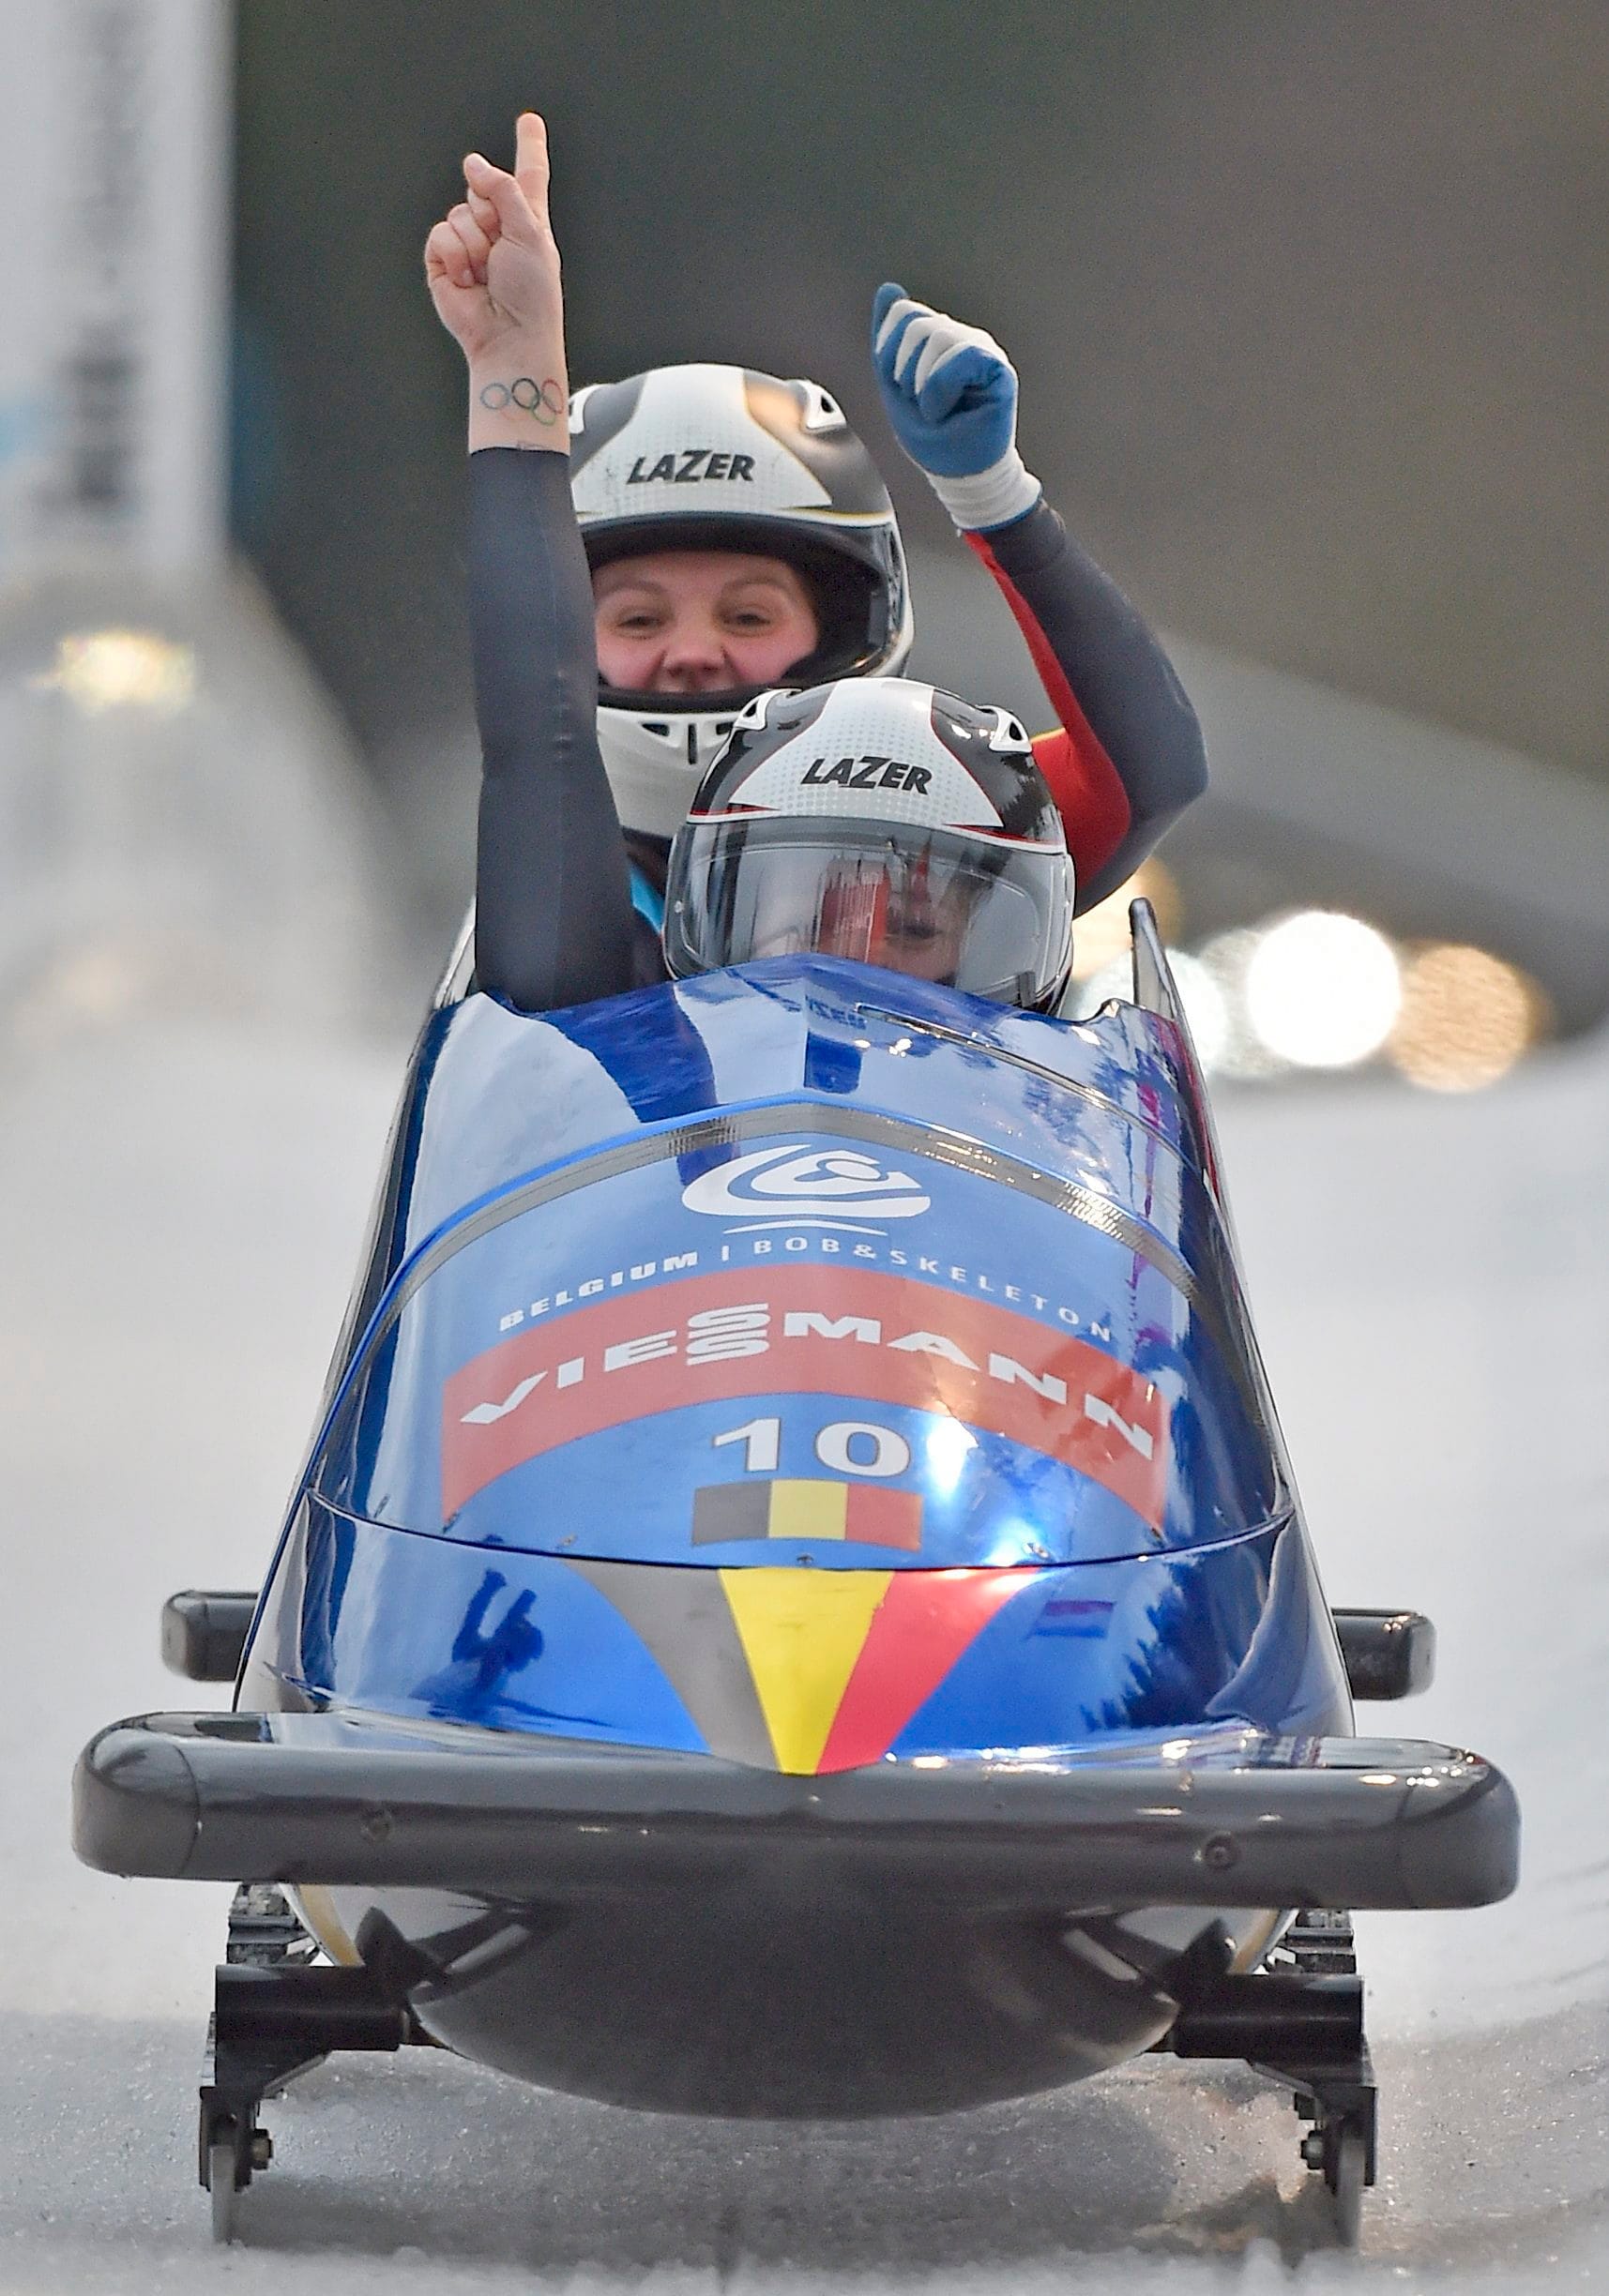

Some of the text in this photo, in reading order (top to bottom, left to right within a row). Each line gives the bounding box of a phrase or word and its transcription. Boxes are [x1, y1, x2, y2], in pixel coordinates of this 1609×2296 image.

[626, 449, 756, 485] LAZER
[800, 756, 933, 795] LAZER
[499, 1251, 698, 1332] BELGIUM
[460, 1303, 1153, 1461] VIESSMANN
[712, 1417, 911, 1477] 10
